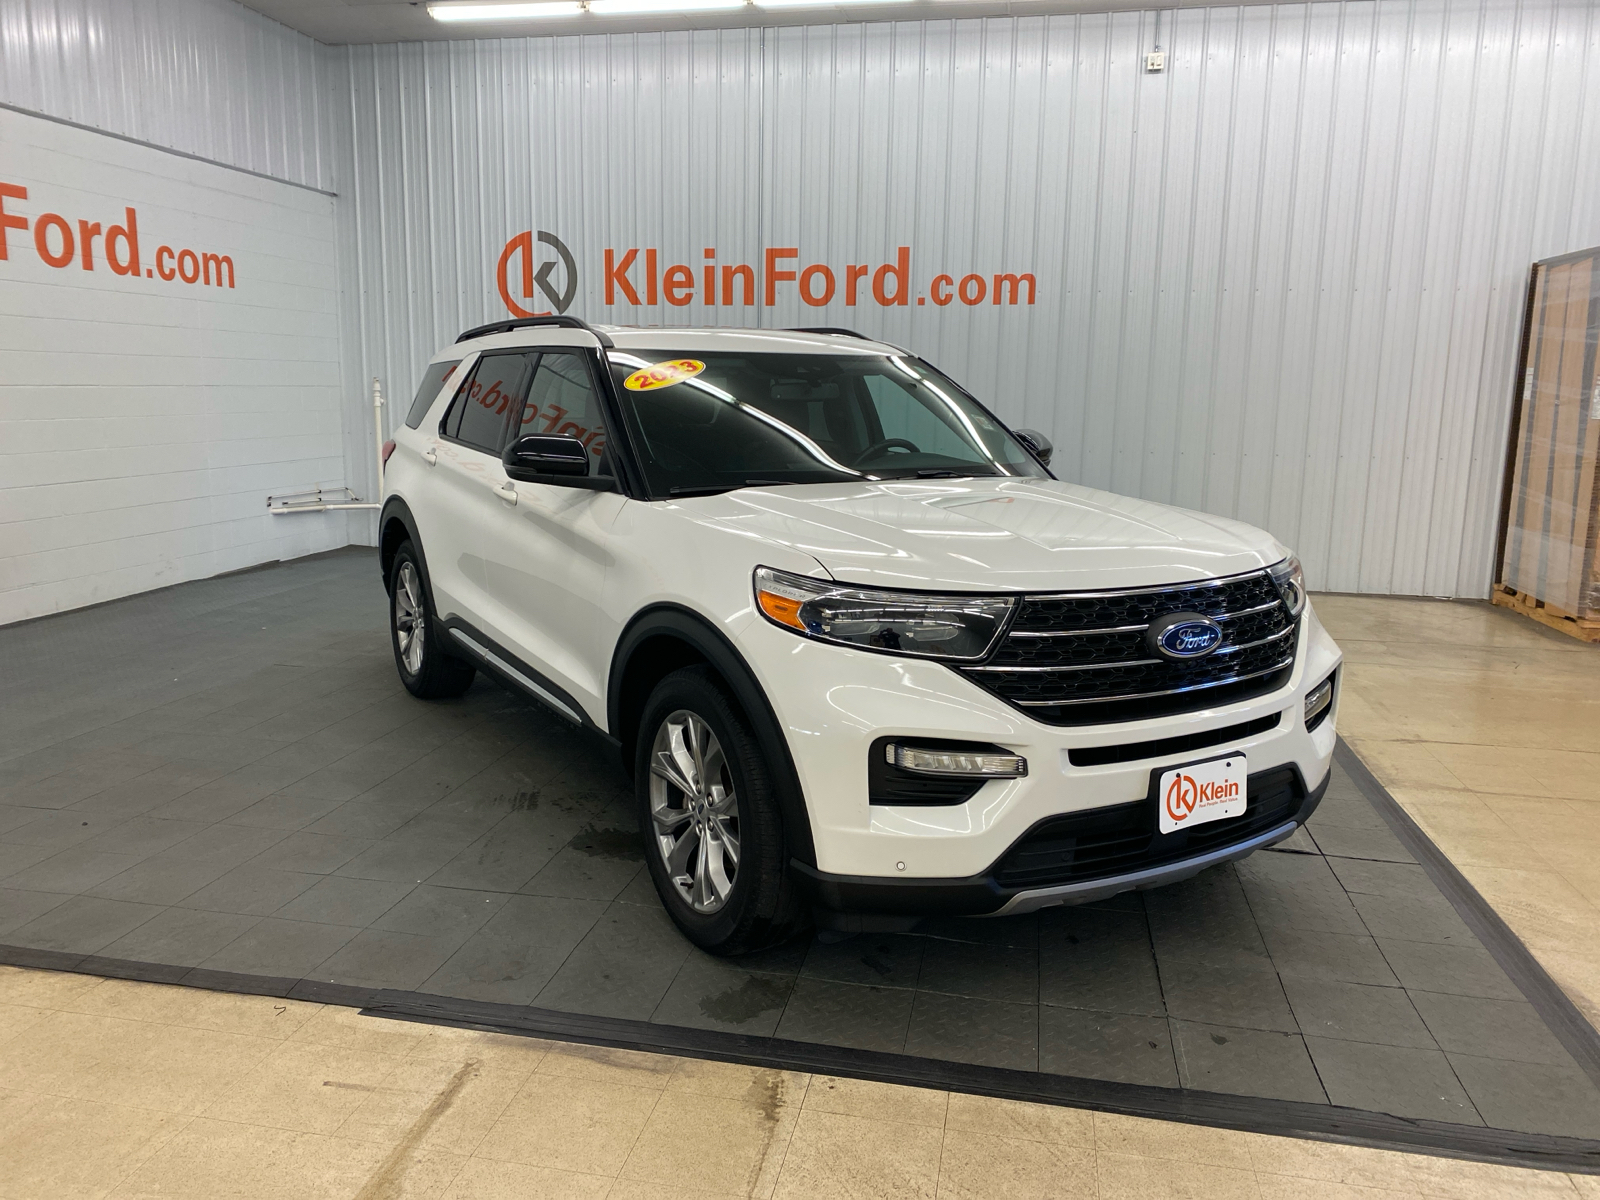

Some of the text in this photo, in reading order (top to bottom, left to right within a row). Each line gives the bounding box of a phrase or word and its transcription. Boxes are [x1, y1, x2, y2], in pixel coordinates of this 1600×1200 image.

[603, 246, 1037, 307] KleinFord.com
[634, 360, 698, 389] 2023
[1176, 627, 1211, 650] Ford
[1199, 778, 1239, 803] Klein
